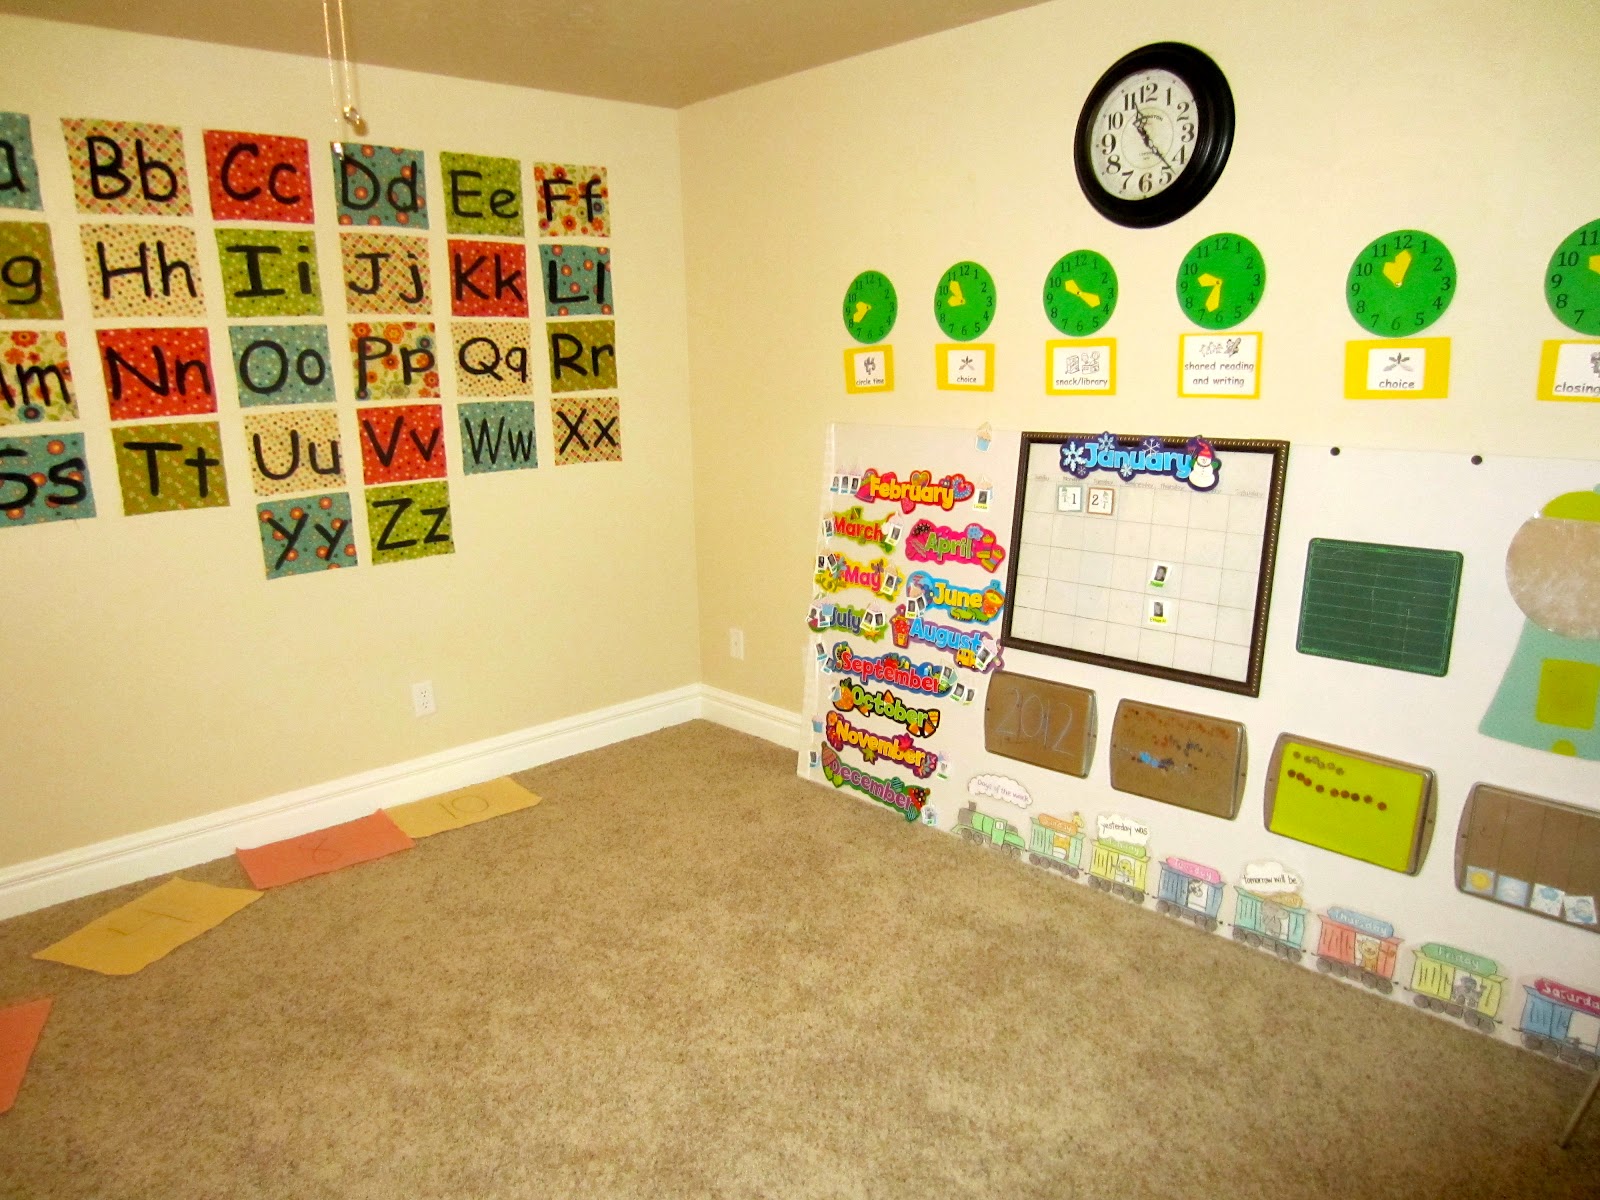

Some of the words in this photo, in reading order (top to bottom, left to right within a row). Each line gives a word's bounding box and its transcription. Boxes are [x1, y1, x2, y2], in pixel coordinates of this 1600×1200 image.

[1140, 82, 1158, 103] 12
[1165, 87, 1172, 106] 1
[1124, 92, 1137, 111] 11
[1177, 101, 1190, 121] 2
[1108, 111, 1123, 130] 10
[1181, 122, 1195, 143] 3
[1101, 133, 1116, 154] 9
[1172, 144, 1187, 165] 4
[86, 135, 179, 202] Bb
[1106, 154, 1121, 174] 8
[221, 142, 301, 204] Cc
[1121, 170, 1134, 190] 7
[1159, 166, 1172, 185] 5
[340, 155, 419, 213] Dd
[1138, 172, 1152, 193] 6
[450, 169, 519, 218] Ee
[542, 178, 602, 223] Ff
[1215, 236, 1229, 251] 12
[1394, 234, 1412, 250] 12
[1578, 230, 1599, 246] 11
[1196, 245, 1209, 258] 11
[1236, 242, 1242, 254] 1
[1372, 244, 1388, 258] 11
[1420, 240, 1428, 254] 1
[1074, 254, 1088, 267] 12
[1092, 258, 1098, 270] 1
[1246, 256, 1254, 270] 2
[1433, 257, 1443, 272] 2
[1558, 251, 1580, 267] 10
[96, 240, 198, 300] Hh
[225, 244, 313, 298] Ii
[960, 265, 970, 276] 12
[974, 269, 978, 280] 1
[1060, 261, 1071, 273] 11
[1184, 262, 1198, 276] 10
[1356, 262, 1372, 277] 10
[348, 252, 424, 304] Jj
[454, 252, 524, 302] Kk
[549, 259, 605, 304] Ll
[948, 272, 956, 282] 11
[1049, 276, 1062, 288] 10
[1102, 272, 1108, 284] 2
[1253, 274, 1260, 286] 3
[1441, 276, 1451, 291] 3
[1551, 274, 1563, 288] 9
[939, 285, 948, 296] 10
[982, 282, 987, 293] 2
[1108, 288, 1114, 300] 3
[1180, 281, 1188, 294] 9
[1352, 282, 1360, 296] 9
[936, 300, 942, 310] 9
[986, 296, 992, 308] 3
[1046, 292, 1053, 304] 9
[1186, 297, 1193, 309] 8
[1248, 292, 1255, 304] 4
[1432, 296, 1442, 310] 4
[1556, 293, 1568, 308] 8
[1051, 306, 1058, 318] 8
[1103, 304, 1109, 315] 4
[1198, 308, 1206, 321] 7
[1234, 306, 1242, 319] 5
[1356, 300, 1365, 314] 8
[940, 312, 946, 323] 8
[983, 311, 990, 322] 4
[1062, 318, 1068, 329] 7
[1092, 316, 1099, 328] 5
[1215, 310, 1223, 322] 6
[1370, 314, 1380, 328] 7
[1391, 316, 1400, 330] 6
[1415, 312, 1424, 326] 5
[1574, 309, 1584, 325] 7
[949, 323, 954, 334] 7
[962, 326, 967, 336] 6
[974, 322, 980, 333] 5
[1076, 320, 1084, 332] 6
[458, 337, 527, 383] Qq
[551, 333, 614, 380] Rr
[105, 344, 212, 401] Nn
[239, 339, 326, 395] Oo
[357, 336, 435, 398] Pp
[1184, 361, 1216, 371] shared
[1219, 361, 1255, 374] reading
[957, 375, 977, 384] choice
[1055, 377, 1109, 388] snack/library
[1192, 377, 1210, 386] and
[1212, 377, 1245, 389] writing
[1378, 378, 1415, 389] choice
[556, 408, 618, 456] Xx
[362, 415, 441, 468] Vv
[464, 416, 534, 465] Ww
[252, 428, 341, 481] Uu
[1084, 442, 1192, 480] January
[123, 441, 220, 499] Tt
[869, 475, 955, 511] February
[371, 497, 450, 551] Zz
[833, 515, 883, 542] March
[266, 512, 350, 571] Yy
[925, 532, 973, 561] April
[844, 565, 882, 593] May
[933, 583, 983, 608] June
[829, 606, 862, 632] July
[910, 618, 984, 652] August
[841, 650, 941, 692] September
[851, 684, 929, 727] October
[995, 687, 1076, 757] 2012
[836, 719, 926, 767] November
[829, 758, 913, 810] December
[438, 794, 490, 820] 10
[1100, 820, 1132, 838] yesterday
[1134, 826, 1148, 835] was
[1243, 874, 1273, 884] tomorrow
